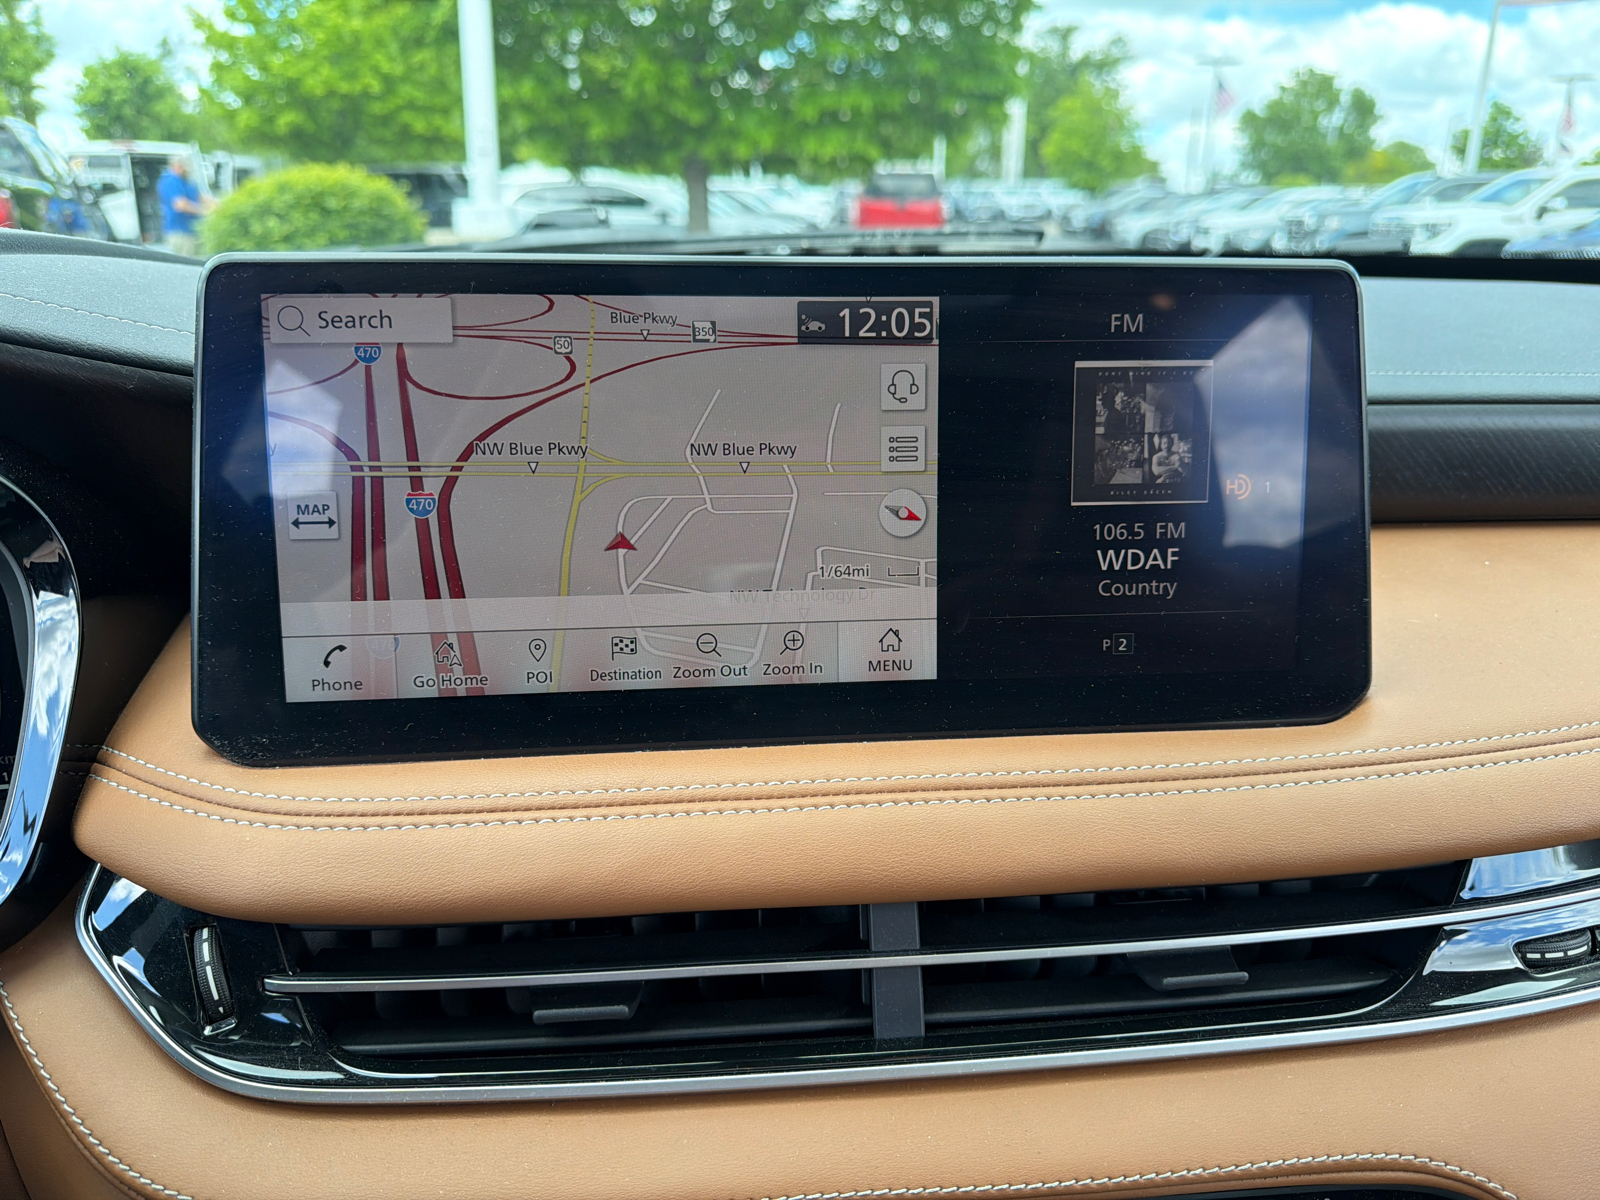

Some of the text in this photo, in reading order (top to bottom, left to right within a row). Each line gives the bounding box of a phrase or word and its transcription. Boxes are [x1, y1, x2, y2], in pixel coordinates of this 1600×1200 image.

[317, 309, 393, 331] Search
[610, 312, 678, 328] Blue Pkwy
[838, 307, 932, 338] 12:05
[1110, 313, 1144, 333] FM
[694, 326, 714, 337] 350
[556, 338, 571, 351] 50
[356, 347, 379, 359] 470
[474, 441, 588, 460] NW Blue Pkwy
[690, 442, 797, 459] NW Blue Pkwy
[1263, 481, 1271, 493] 1
[296, 503, 331, 516] MAP
[408, 499, 434, 512] 470
[1093, 522, 1186, 541] 106.5 FM
[1096, 548, 1180, 571] WDAF
[819, 565, 870, 578] 1/64mi
[1098, 579, 1178, 600] Country
[1102, 638, 1128, 651] P 2
[672, 664, 748, 679] Zoom Out
[762, 662, 823, 676] Zoom In
[868, 659, 913, 673] MENU
[413, 674, 489, 689] Go Home
[525, 671, 553, 685] POI
[589, 667, 663, 682] Destination
[311, 677, 363, 692] Phone
